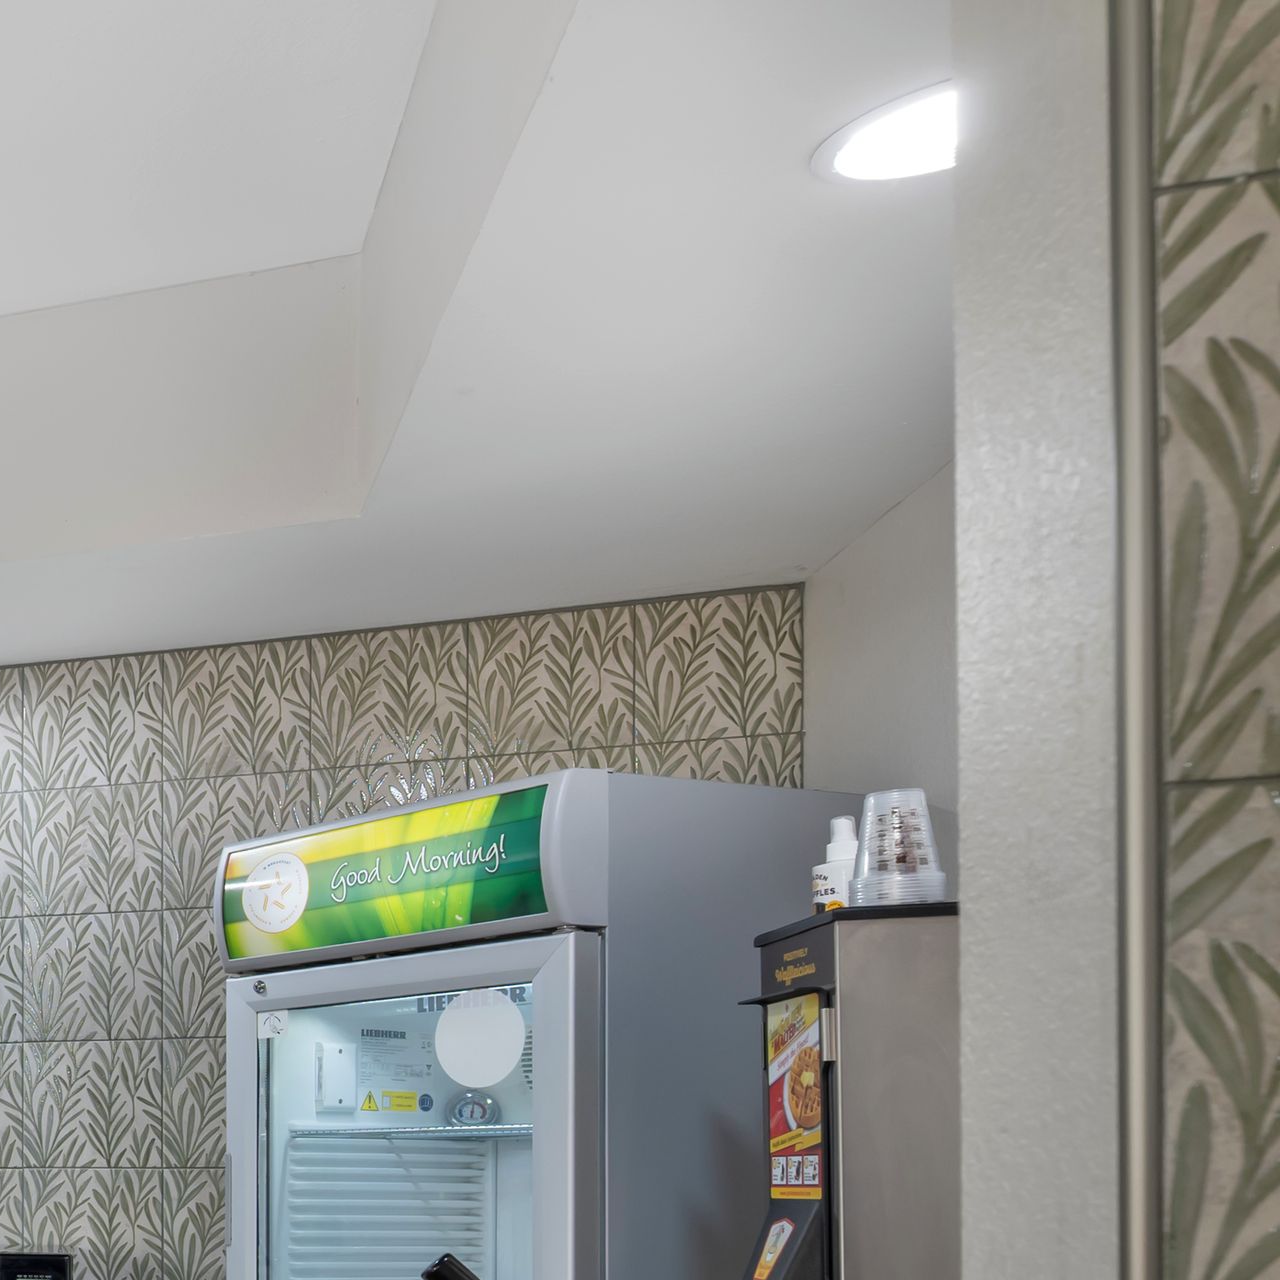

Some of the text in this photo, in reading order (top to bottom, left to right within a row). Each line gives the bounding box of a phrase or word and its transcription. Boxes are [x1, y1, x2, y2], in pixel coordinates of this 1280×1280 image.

[330, 857, 381, 903] Good
[387, 833, 507, 884] Morning!
[360, 1028, 408, 1041] LIEBHERR
